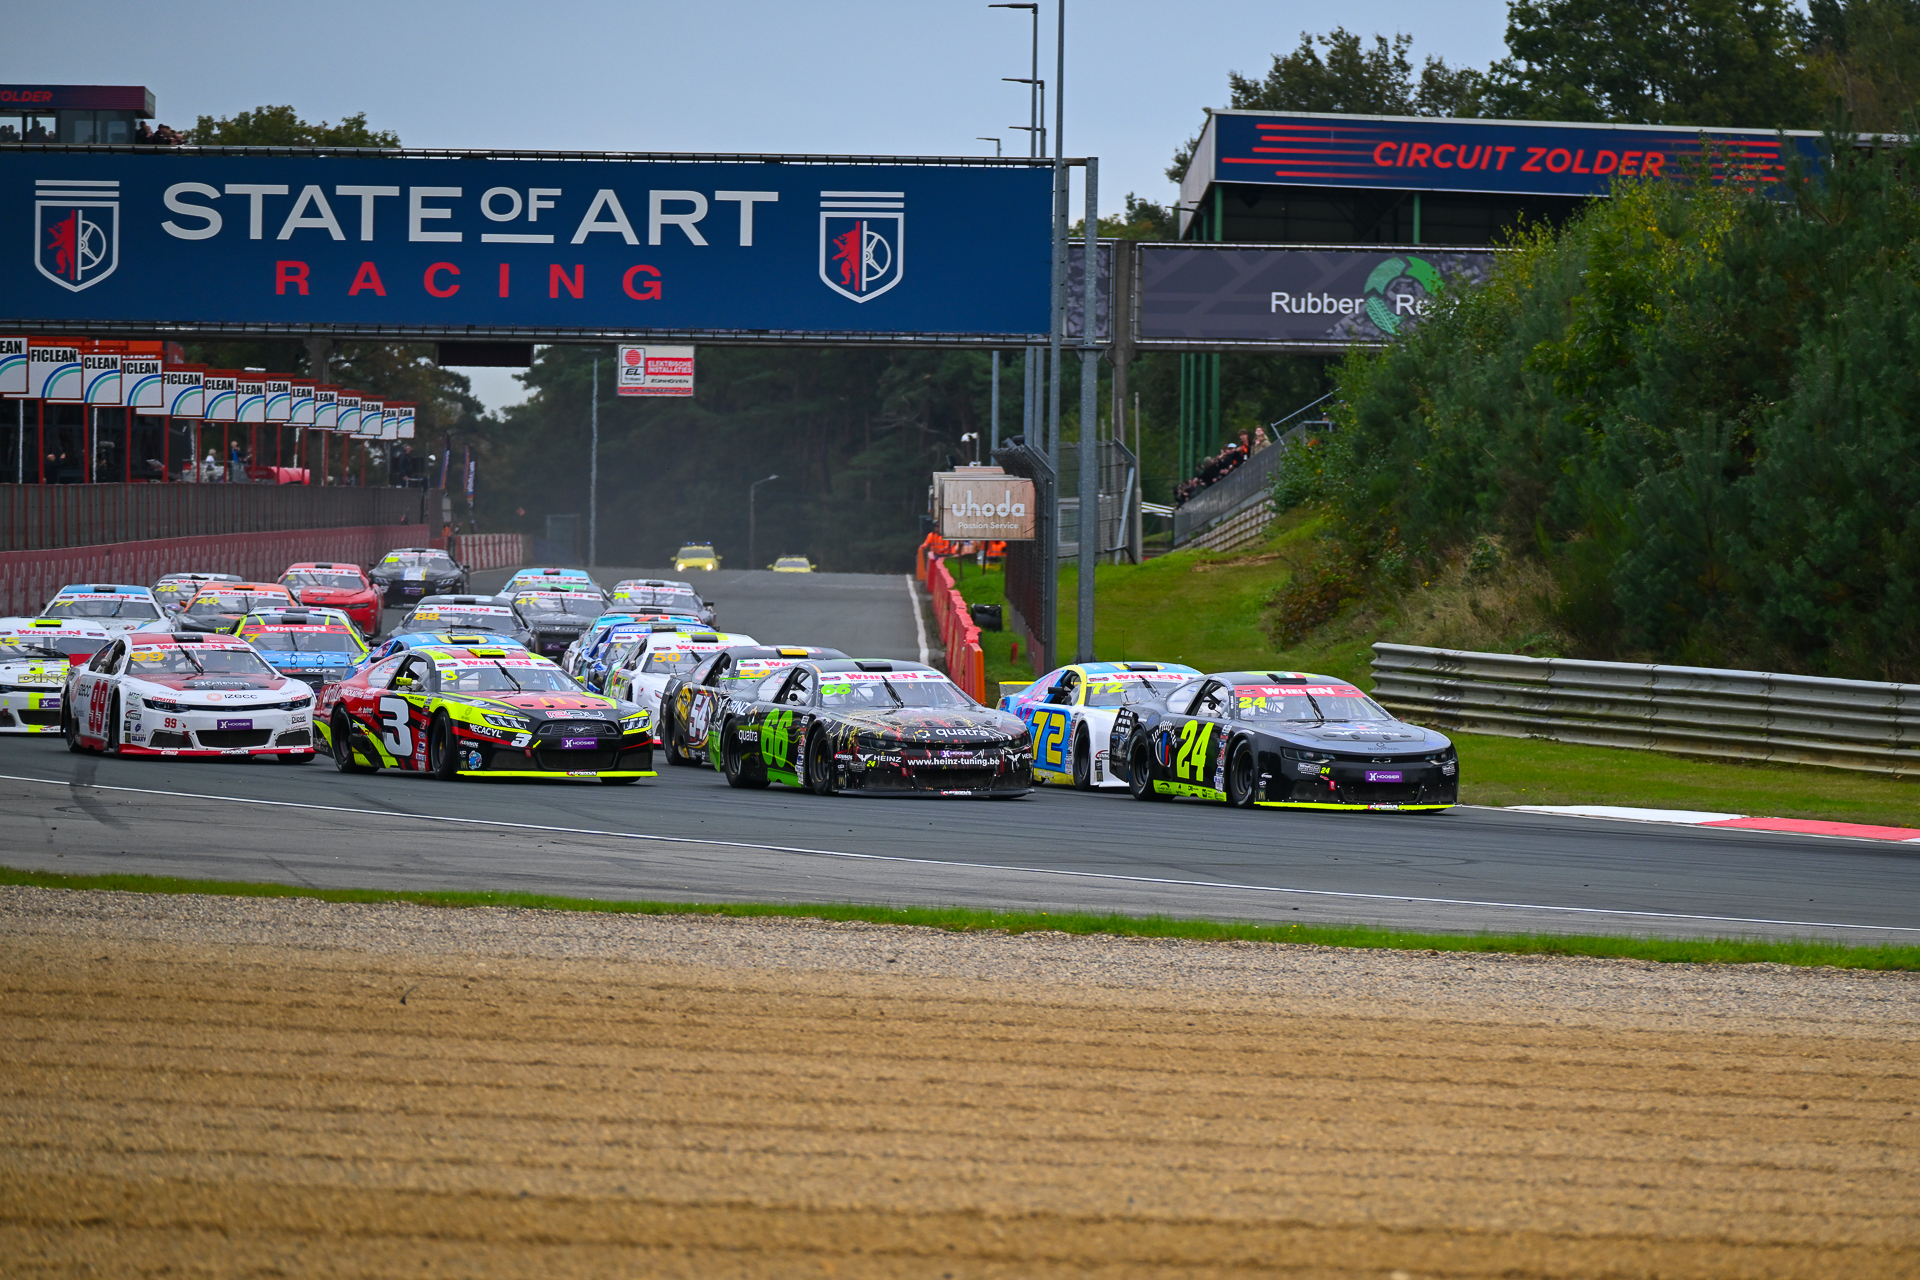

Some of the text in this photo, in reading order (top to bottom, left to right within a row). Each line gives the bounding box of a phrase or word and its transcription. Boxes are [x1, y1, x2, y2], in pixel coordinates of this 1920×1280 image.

[1373, 141, 1665, 177] CIRCUIT ZOLDER
[161, 182, 779, 247] STATE OF ART
[275, 260, 662, 300] RACING
[1270, 291, 1364, 315] Rubber
[31, 348, 77, 363] FICLEAN
[267, 382, 289, 393] LEAN
[952, 490, 1025, 517] uhoda
[958, 521, 1019, 529] Passion Service
[414, 612, 440, 621] 88
[245, 633, 260, 643] 7
[131, 651, 165, 662] 99
[653, 652, 681, 663] 50
[441, 669, 458, 681] 3
[1113, 673, 1184, 681] WHELEN
[821, 683, 852, 695] 66
[1087, 682, 1126, 695] 72
[1260, 686, 1336, 696] WHELEN
[1239, 696, 1267, 709] 24
[164, 717, 178, 729] 99
[380, 696, 413, 757] 3
[738, 729, 758, 743] quatra
[761, 707, 794, 768] 66
[935, 728, 990, 738] quatra
[1032, 710, 1067, 765] 72
[510, 732, 533, 748] 3
[1176, 719, 1215, 782] 24
[873, 754, 902, 763] HEINZ
[907, 757, 1001, 767] www.heinz-tuning.be
[1320, 767, 1331, 775] 24
